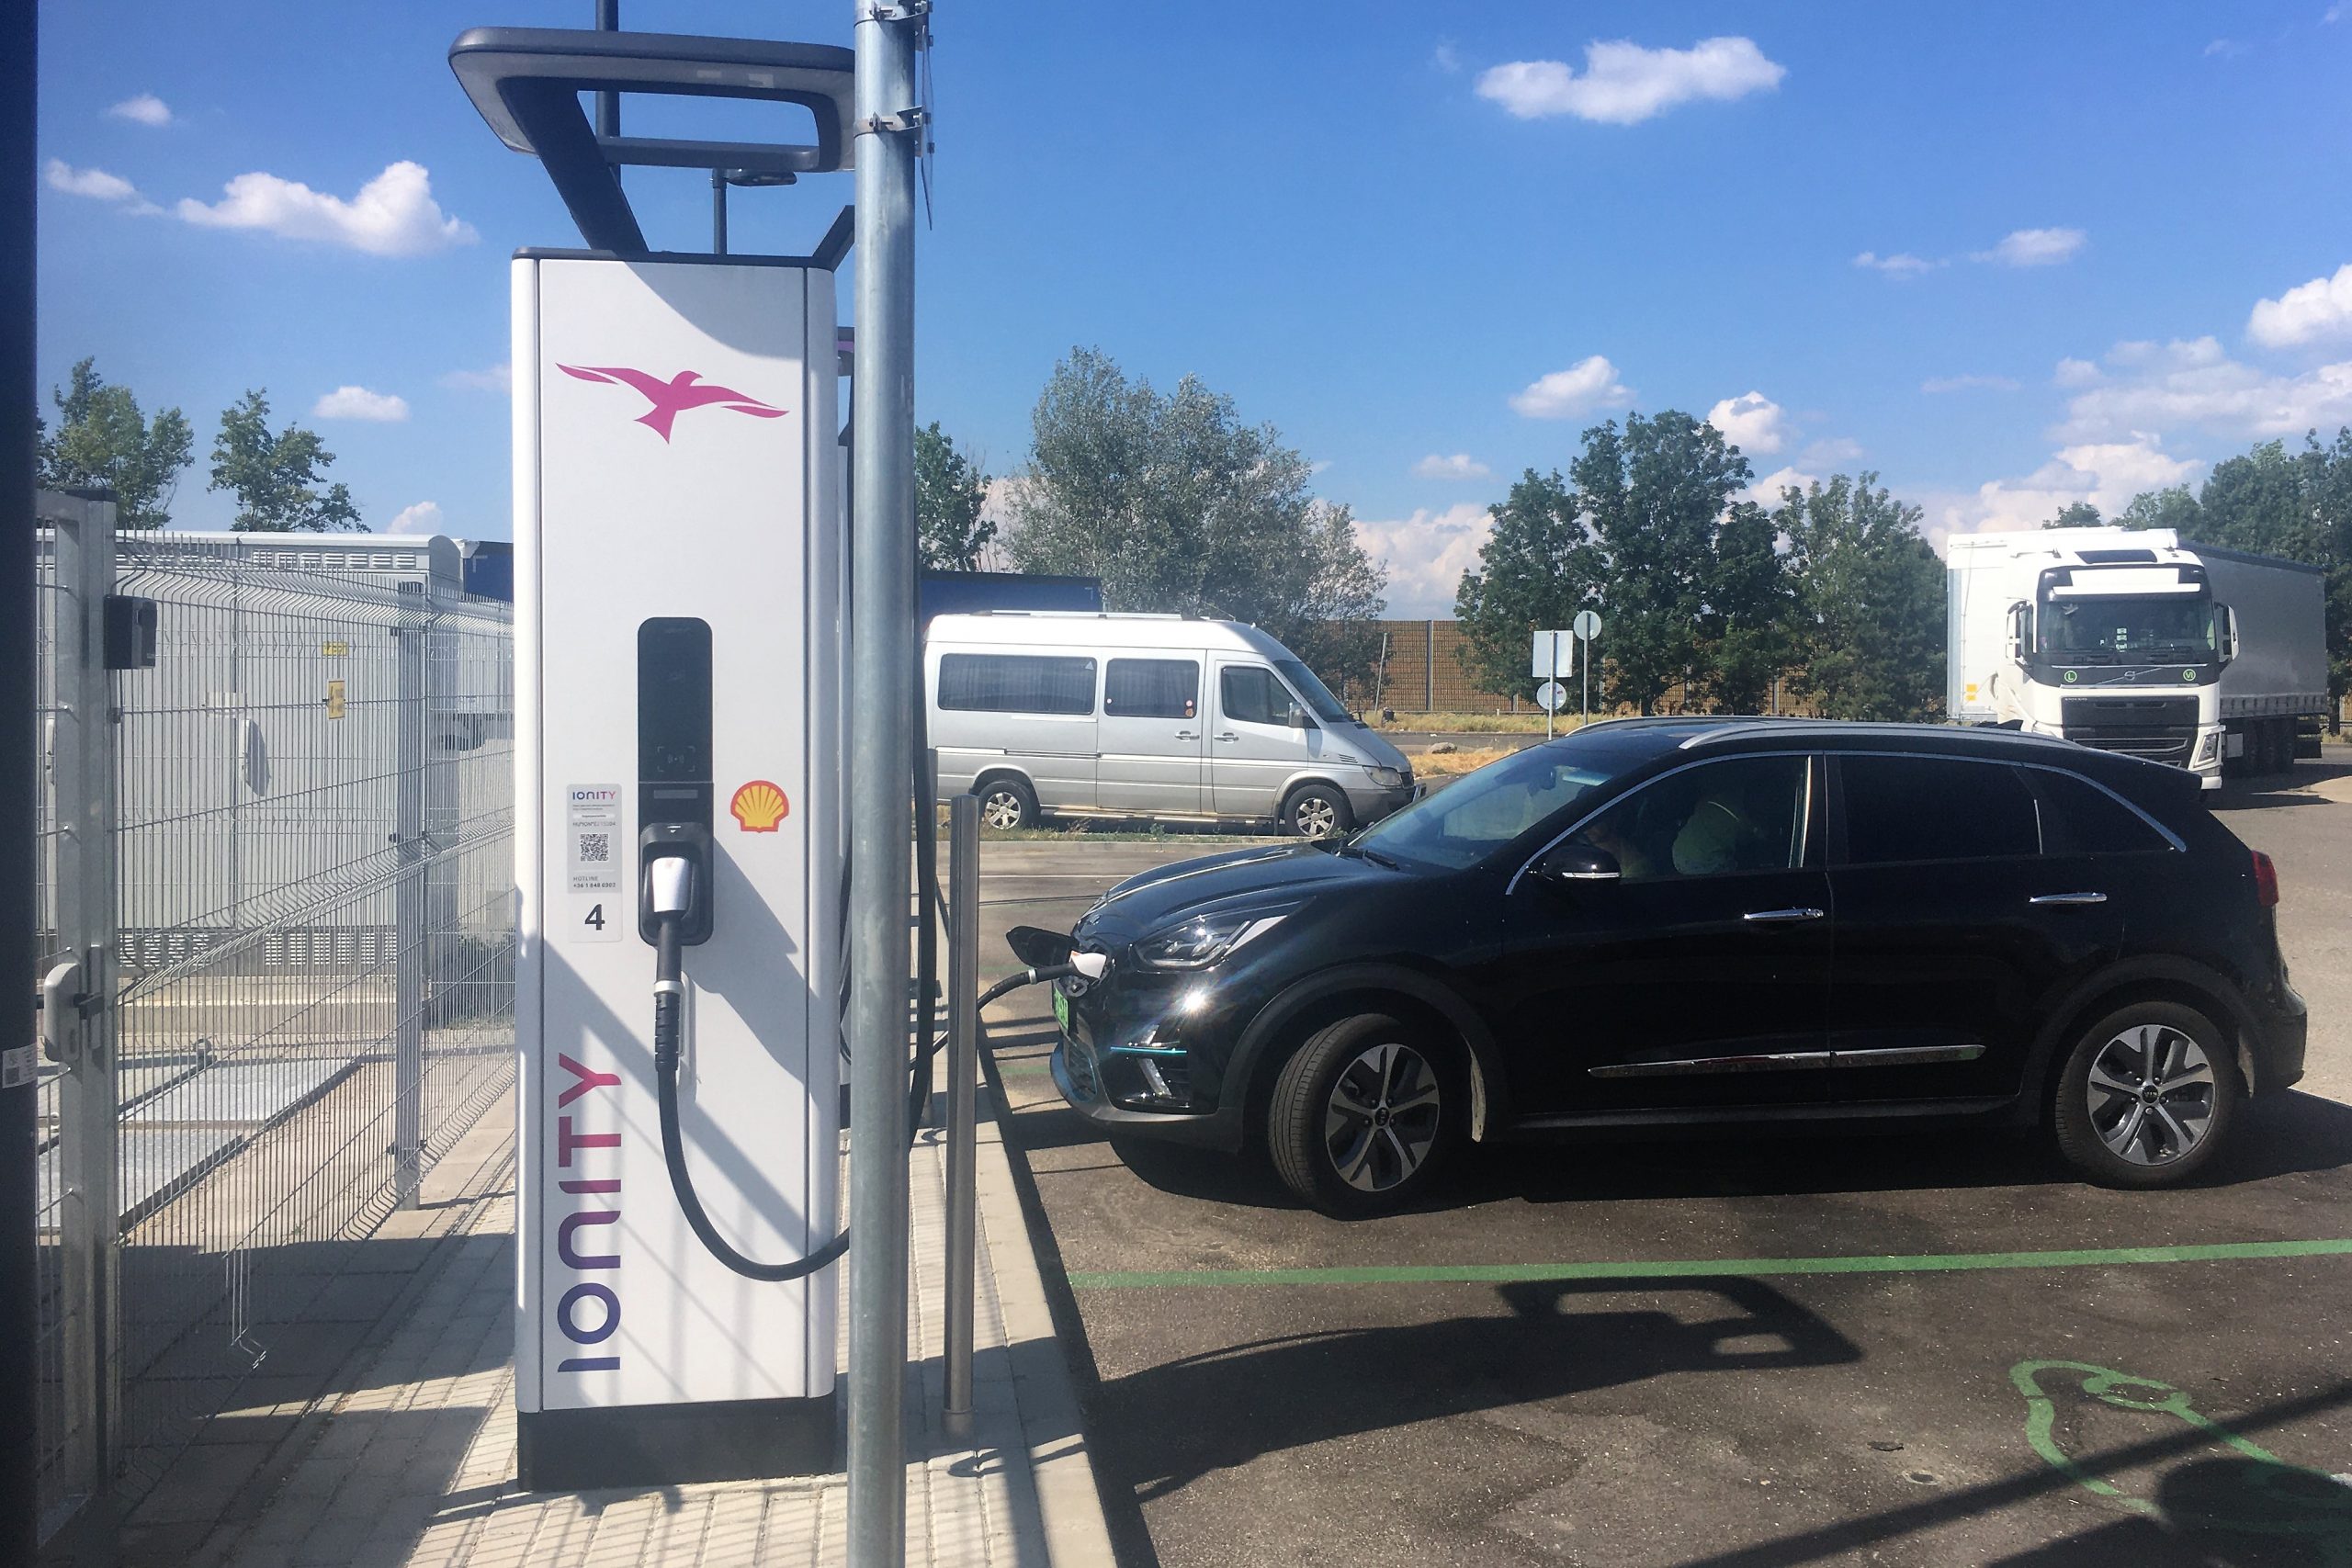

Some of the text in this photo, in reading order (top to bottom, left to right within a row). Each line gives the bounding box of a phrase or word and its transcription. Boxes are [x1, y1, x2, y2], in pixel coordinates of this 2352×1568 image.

[572, 791, 616, 800] IONITY
[584, 904, 605, 931] 4
[557, 1052, 622, 1372] IONITY
